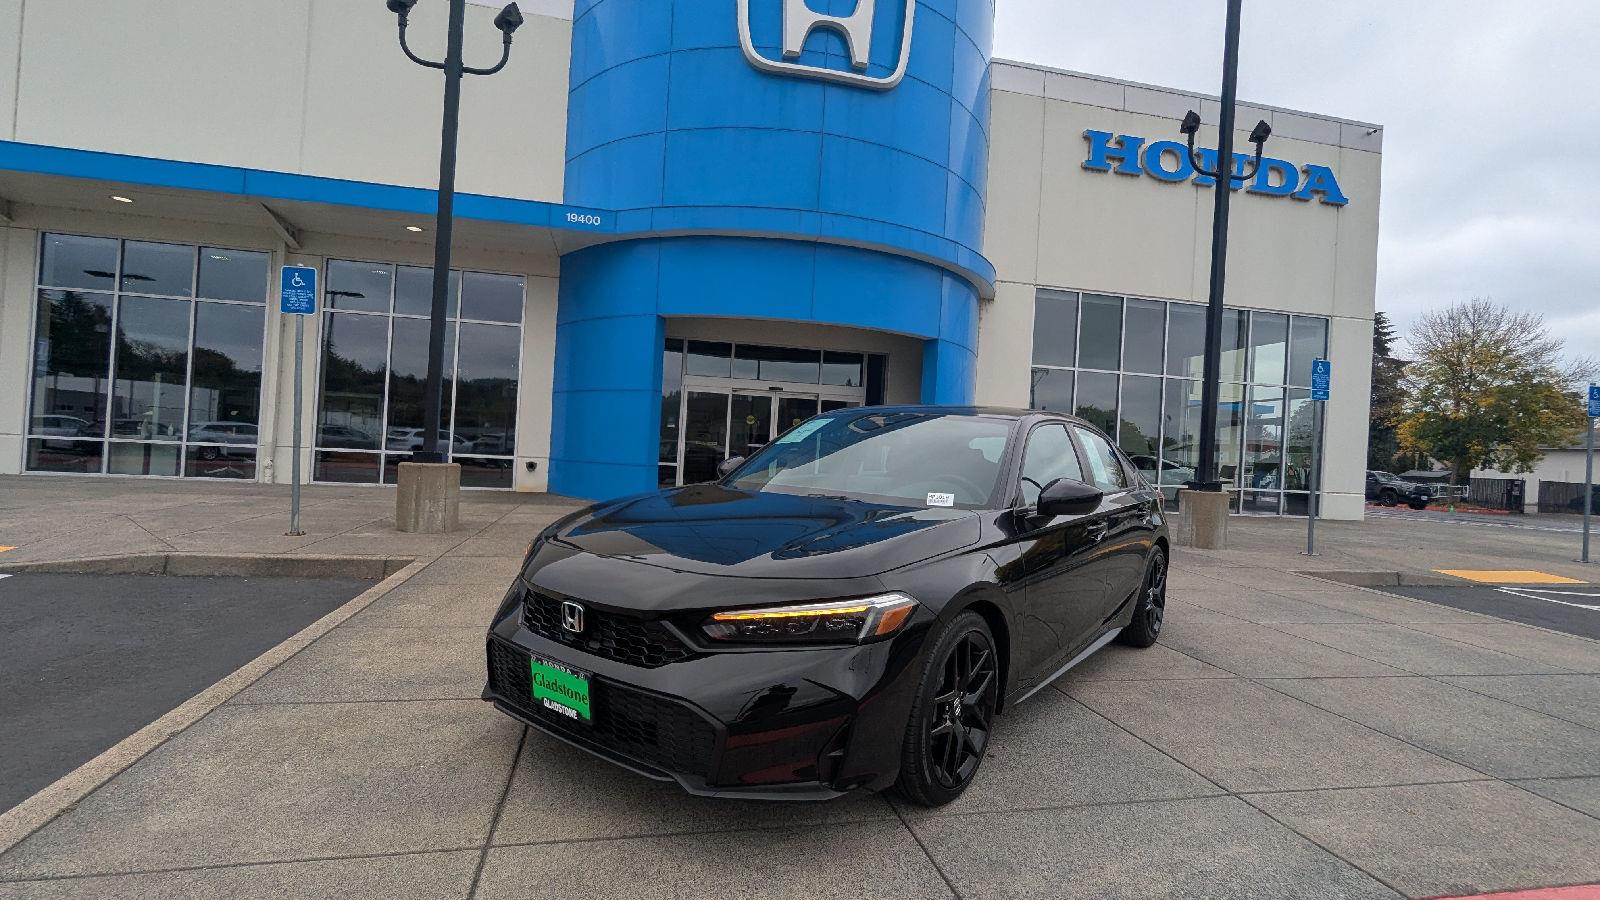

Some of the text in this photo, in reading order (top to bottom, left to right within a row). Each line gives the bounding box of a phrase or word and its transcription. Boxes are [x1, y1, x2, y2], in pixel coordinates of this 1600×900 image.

[1082, 129, 1349, 206] HONDA
[565, 212, 601, 226] 19400
[533, 672, 589, 705] Gladstone
[543, 697, 578, 720] GLADSTONE
